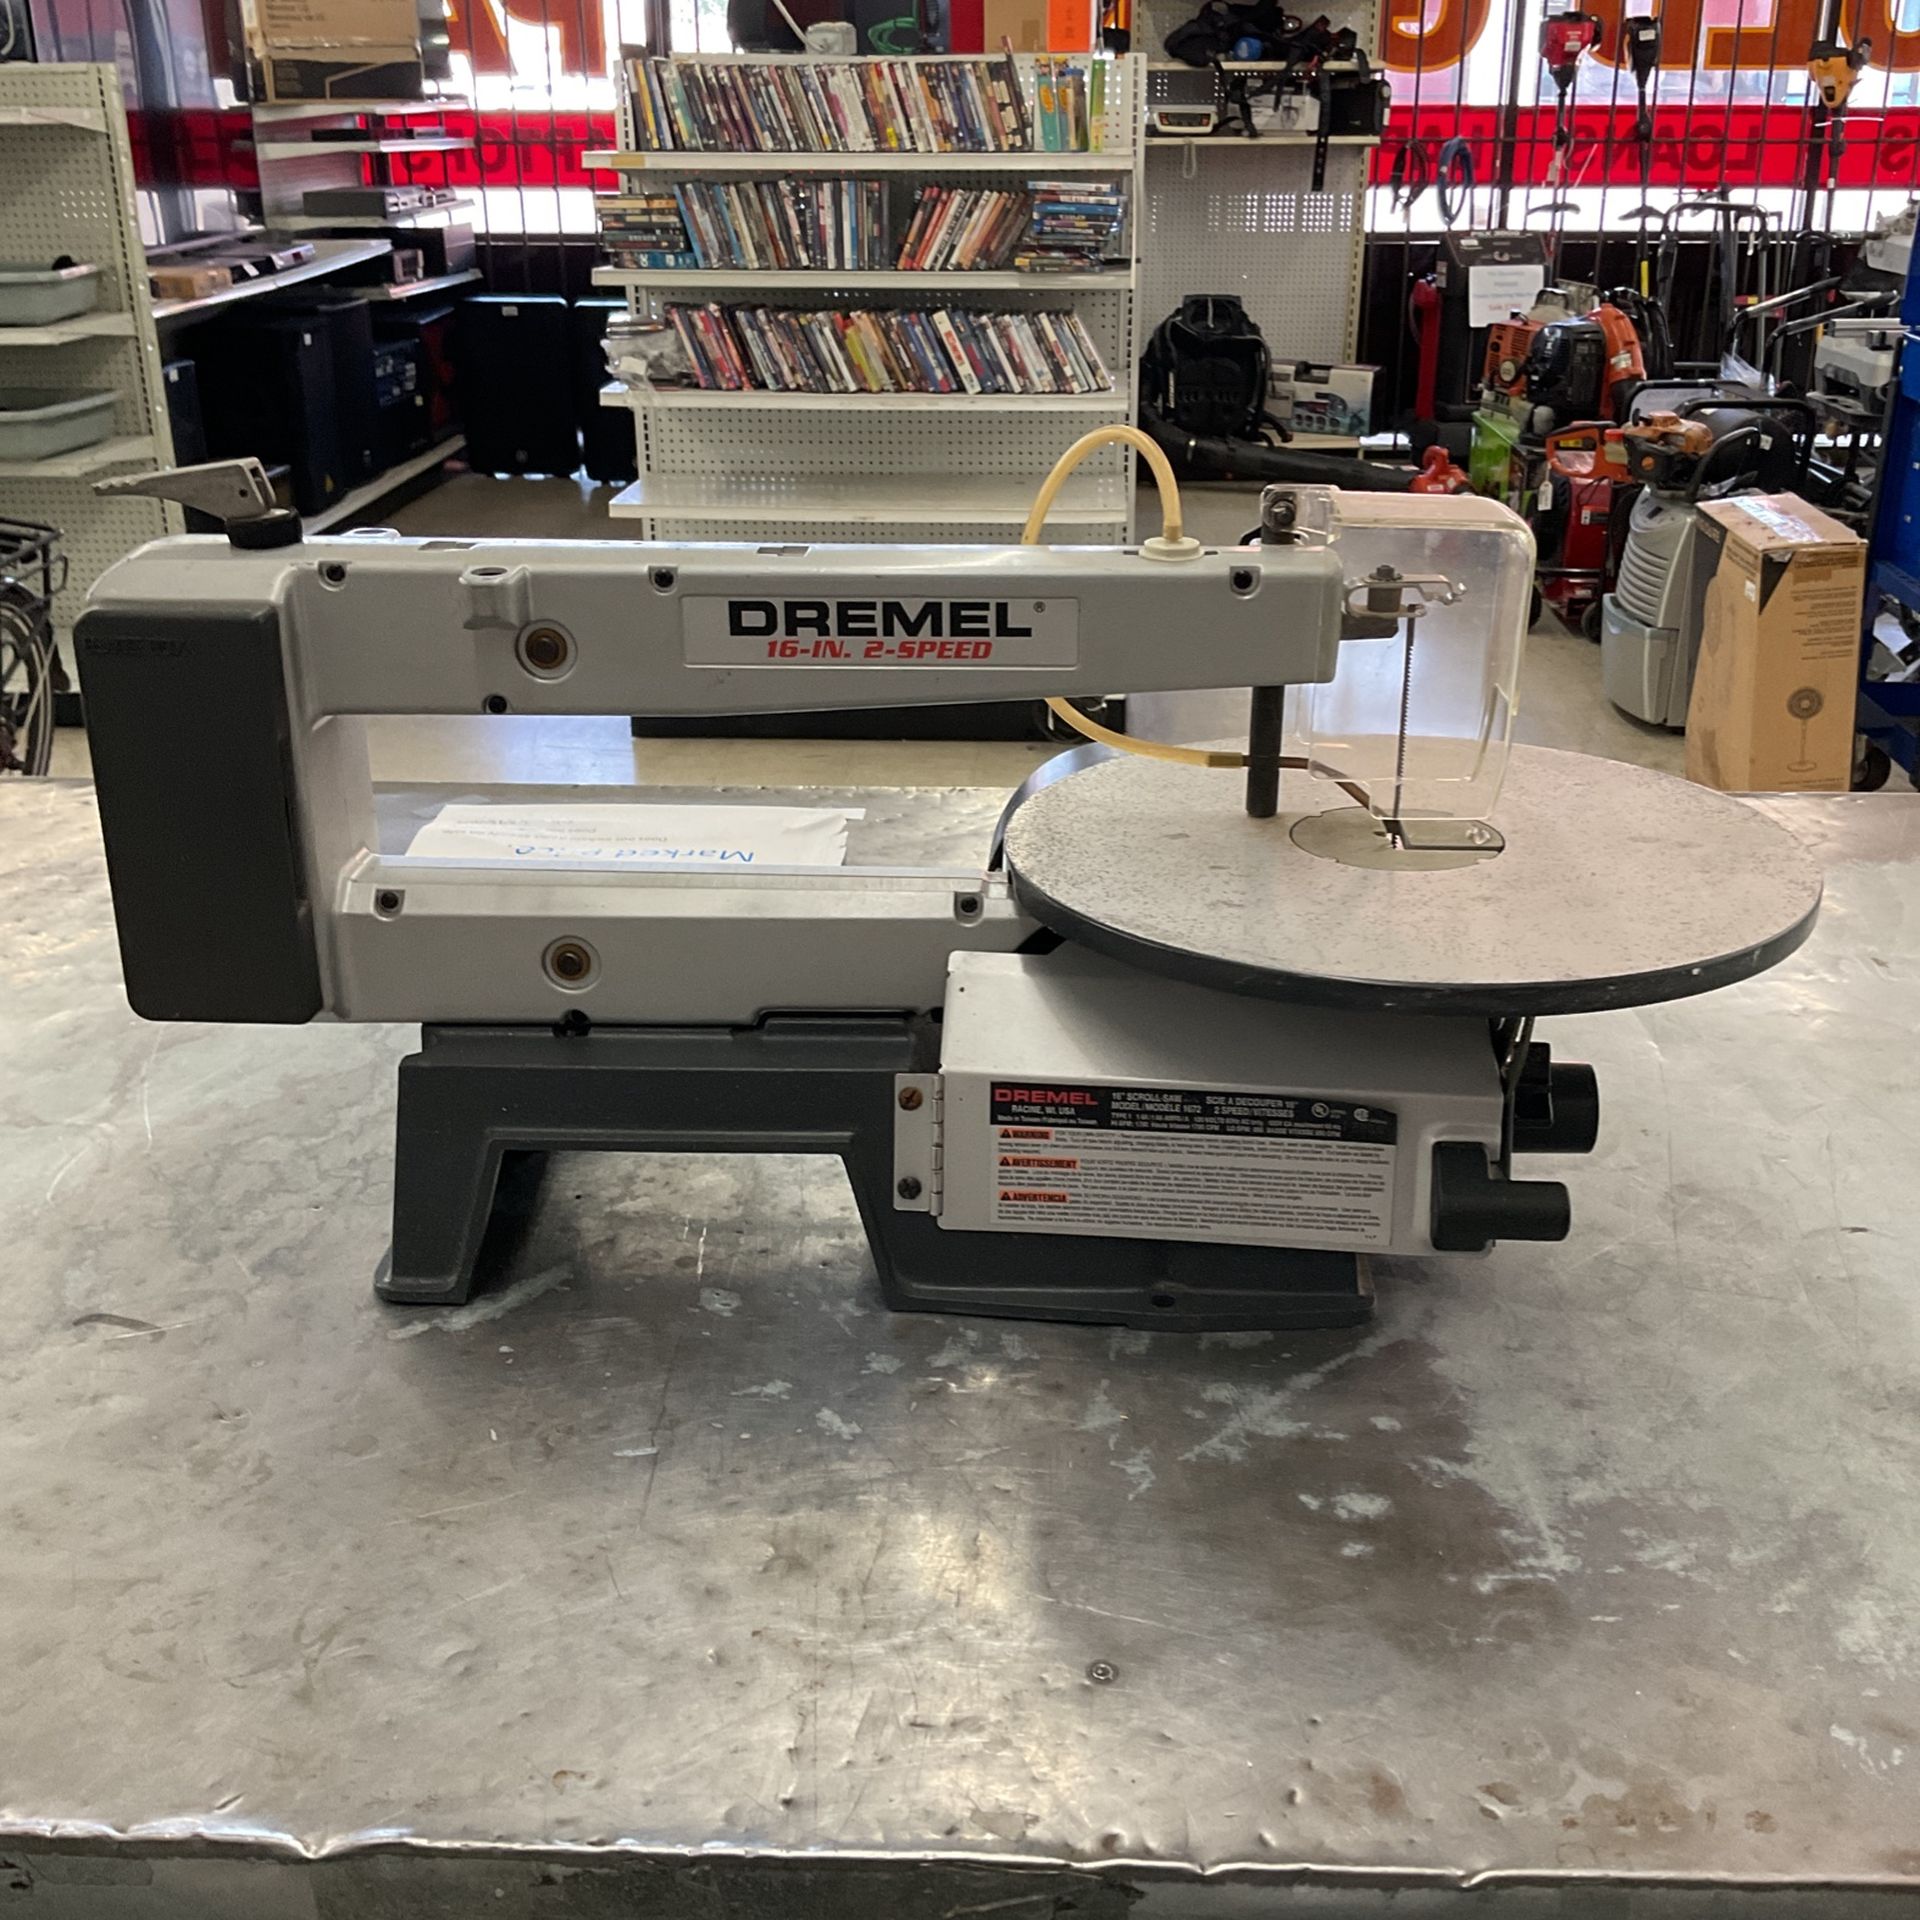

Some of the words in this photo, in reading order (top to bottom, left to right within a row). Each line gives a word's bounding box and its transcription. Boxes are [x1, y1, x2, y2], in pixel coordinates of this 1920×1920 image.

[728, 600, 1032, 638] DREMEL
[767, 640, 852, 659] 16-IN.
[863, 640, 994, 660] 2-SPEED
[994, 1088, 1099, 1106] DREMEL
